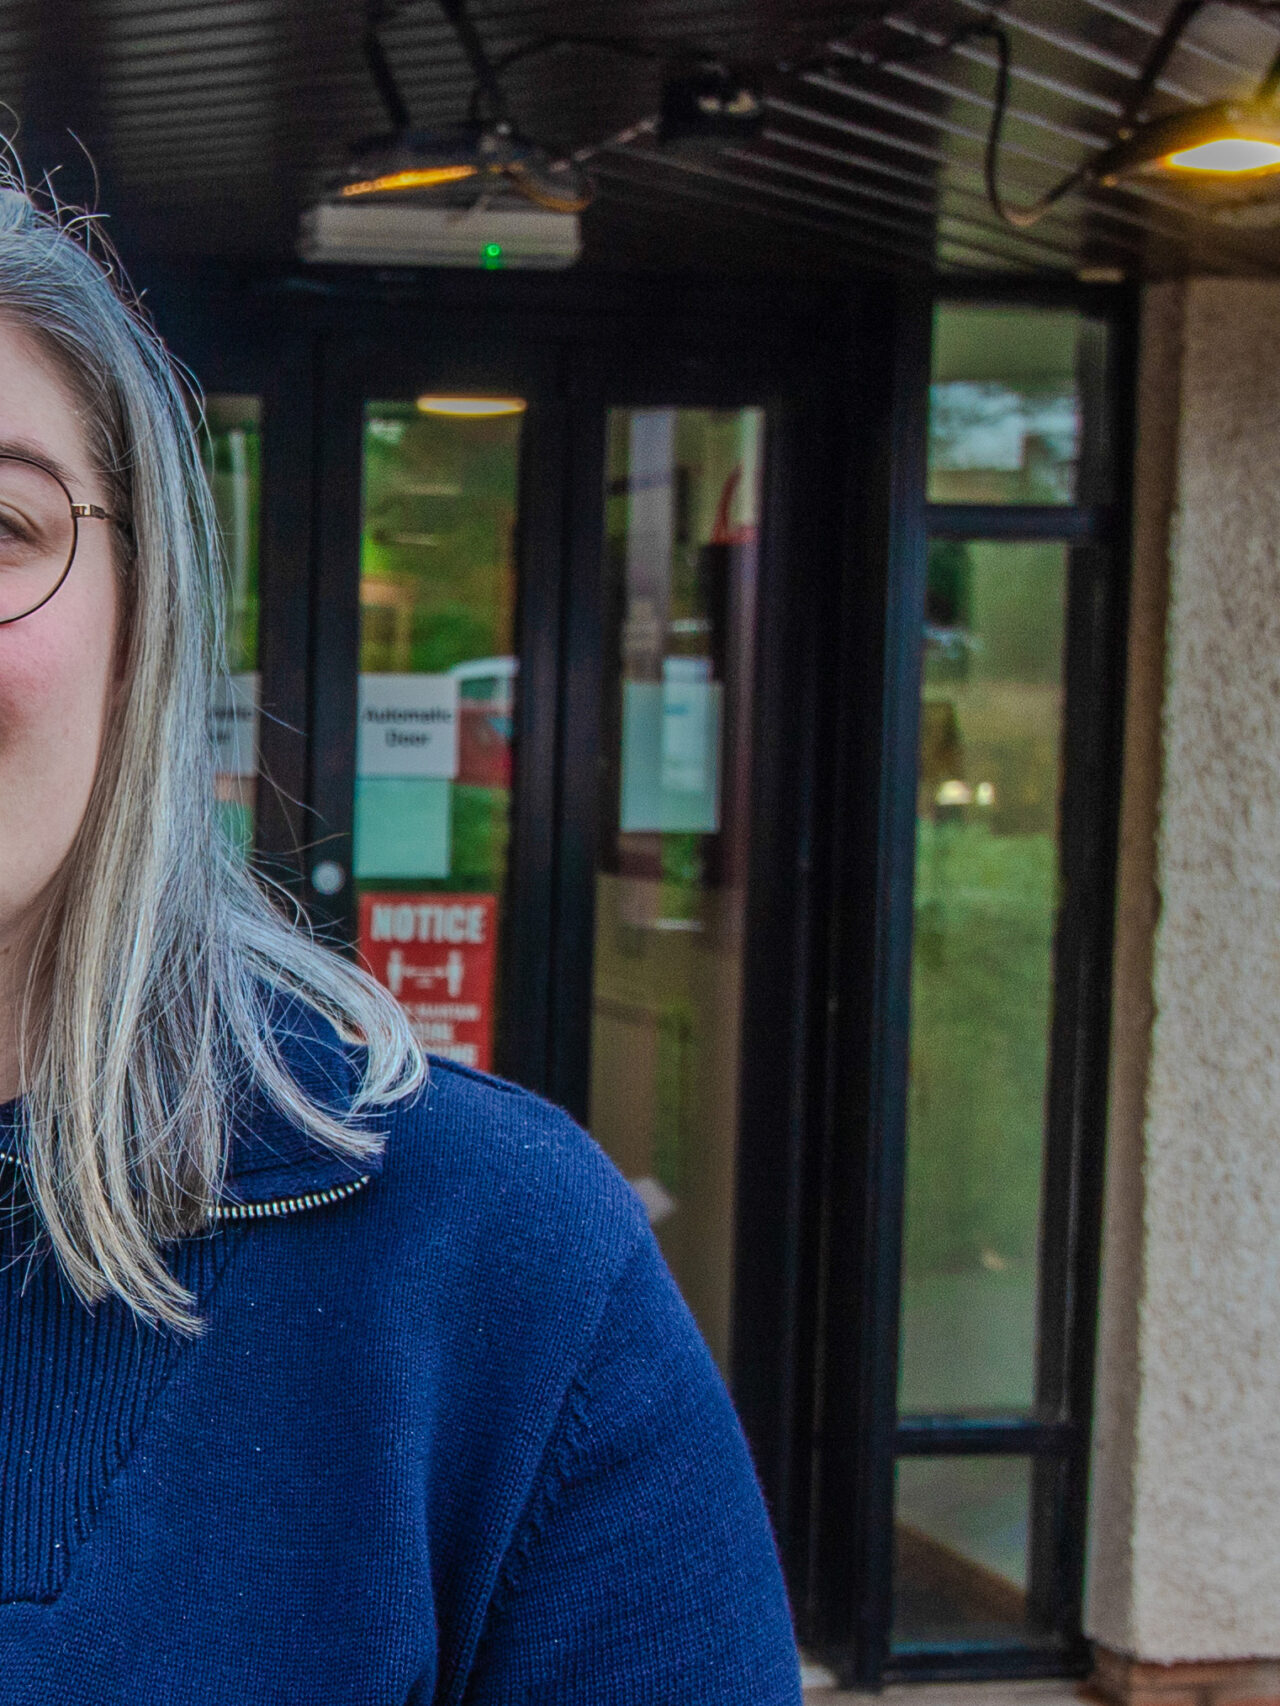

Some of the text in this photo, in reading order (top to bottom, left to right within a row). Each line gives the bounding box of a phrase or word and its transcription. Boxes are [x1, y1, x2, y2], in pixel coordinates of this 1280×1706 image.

[365, 706, 452, 723] Automatic
[385, 730, 429, 748] Door
[370, 903, 486, 943] NOTICE
